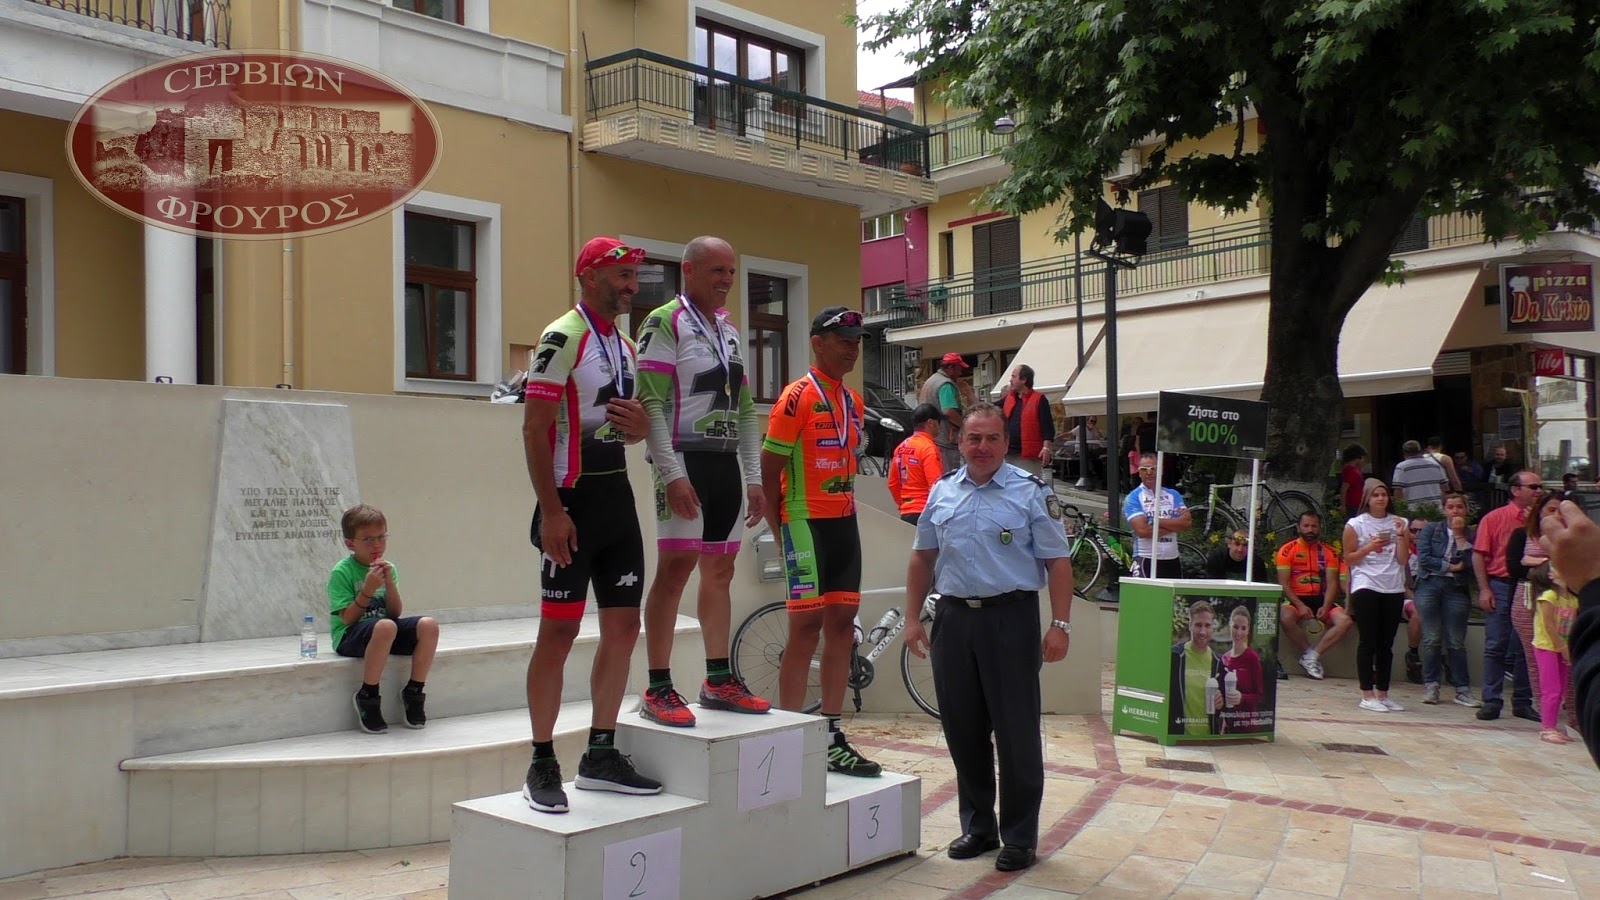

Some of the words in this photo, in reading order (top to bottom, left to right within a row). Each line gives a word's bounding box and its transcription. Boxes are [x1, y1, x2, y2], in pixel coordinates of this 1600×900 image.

[1532, 269, 1588, 292] pizza
[1510, 290, 1539, 323] Da
[1536, 353, 1562, 373] illy
[1188, 404, 1219, 419] Ζήστε
[1221, 410, 1240, 421] στο
[706, 428, 738, 438] BIKES
[1187, 421, 1238, 445] 100%
[240, 487, 261, 496] ΥΠΟ
[266, 487, 286, 496] ΤΑΣ
[323, 487, 341, 496] ΤΗΣ
[250, 509, 267, 518] ΚΑΙ
[271, 509, 290, 518] ΤΑΣ
[295, 508, 331, 518] ΔΑΦΝΑΣ
[299, 518, 329, 528] ΔΟΞΗΣ
[872, 619, 905, 658] COLNAG
[757, 745, 775, 796] 1
[866, 804, 880, 840] 3
[628, 851, 647, 898] 2
